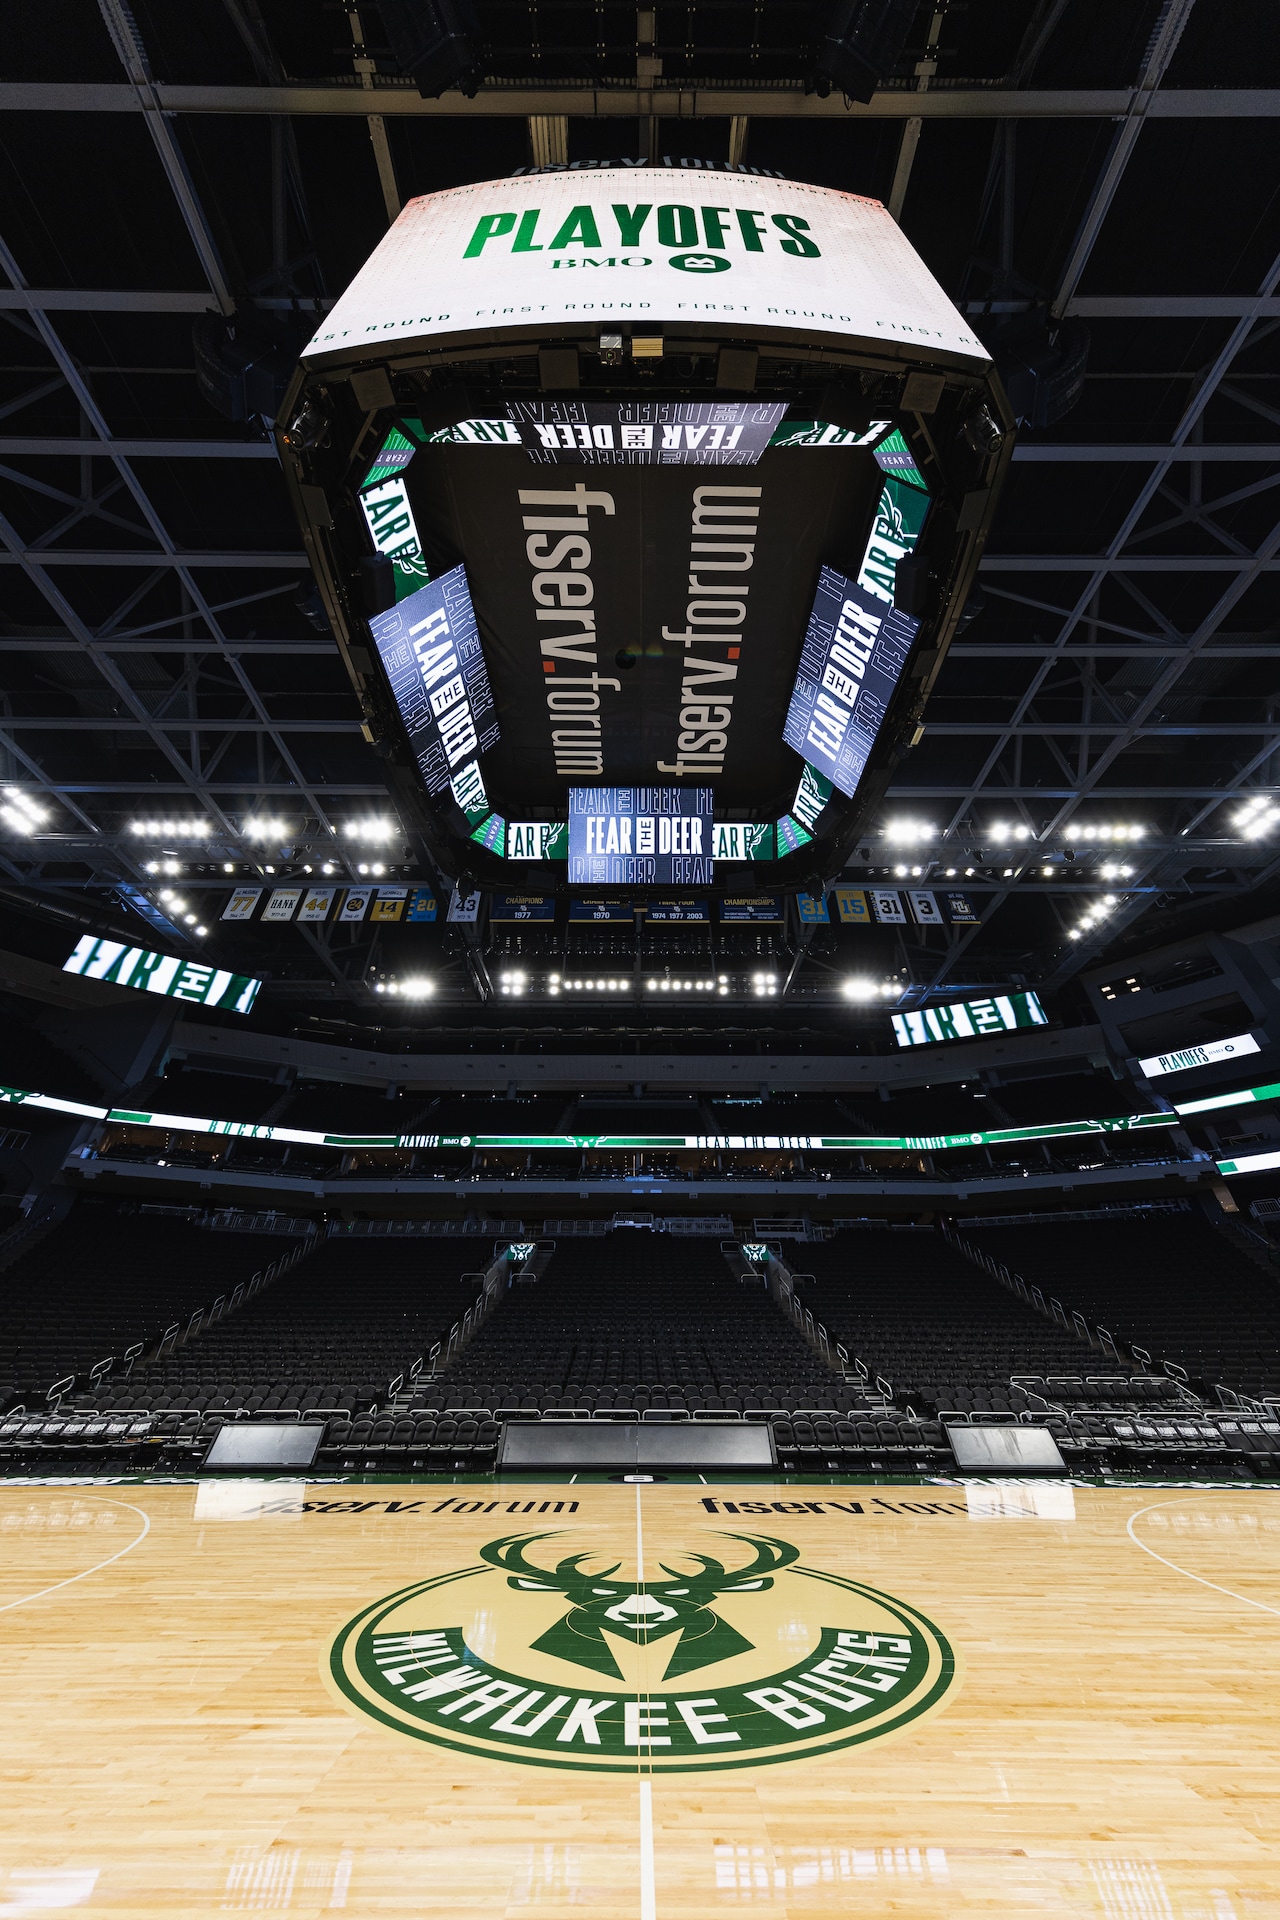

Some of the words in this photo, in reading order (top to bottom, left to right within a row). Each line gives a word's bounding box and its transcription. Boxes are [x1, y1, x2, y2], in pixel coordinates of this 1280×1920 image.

[462, 203, 822, 259] PLAYOFFS
[549, 257, 653, 270] BMO
[365, 313, 451, 333] ROUND
[475, 304, 550, 317] FIRST
[564, 301, 652, 310] ROUND
[677, 302, 751, 311] FIRST
[766, 306, 852, 322] ROUND
[875, 319, 944, 338] FIRST
[532, 424, 614, 449] DEER
[660, 425, 745, 450] FEAR
[384, 454, 407, 463] FEAR
[882, 456, 905, 465] FEAR
[829, 598, 883, 680] DEER
[408, 606, 458, 690] FEAR
[825, 668, 853, 700] THE
[433, 681, 463, 711] THE
[436, 700, 478, 769] DEER
[806, 691, 851, 763] FEAR
[586, 816, 632, 855] FEAR
[640, 820, 652, 851] THE
[659, 816, 703, 855] DEER
[230, 896, 256, 912] 77
[270, 899, 296, 909] HANK
[305, 898, 329, 911] 44
[347, 899, 364, 910] 24
[378, 901, 398, 912] 14
[416, 899, 437, 911] 20
[455, 899, 476, 912] 43
[724, 898, 776, 906] CHAMPIONSHIPS
[802, 900, 825, 915] 31
[841, 899, 866, 914] 15
[880, 900, 902, 915] 31
[917, 900, 933, 915] 3
[513, 911, 532, 919] 1977
[592, 911, 611, 919] 1970
[651, 912, 666, 920] 1974
[669, 912, 684, 920] 1977
[686, 912, 703, 920] 2003
[1158, 1046, 1210, 1072] PLAYOFFS
[207, 1119, 275, 1139] BUCKS
[398, 1135, 440, 1148] PLAYOFFS
[697, 1135, 730, 1149] FEAR
[779, 1135, 813, 1149] DEER
[904, 1136, 948, 1150] PLAYOFFS
[950, 1137, 970, 1145] BMO
[371, 1631, 742, 1747] MILWAUKEE
[742, 1630, 914, 1728] BUCKS
